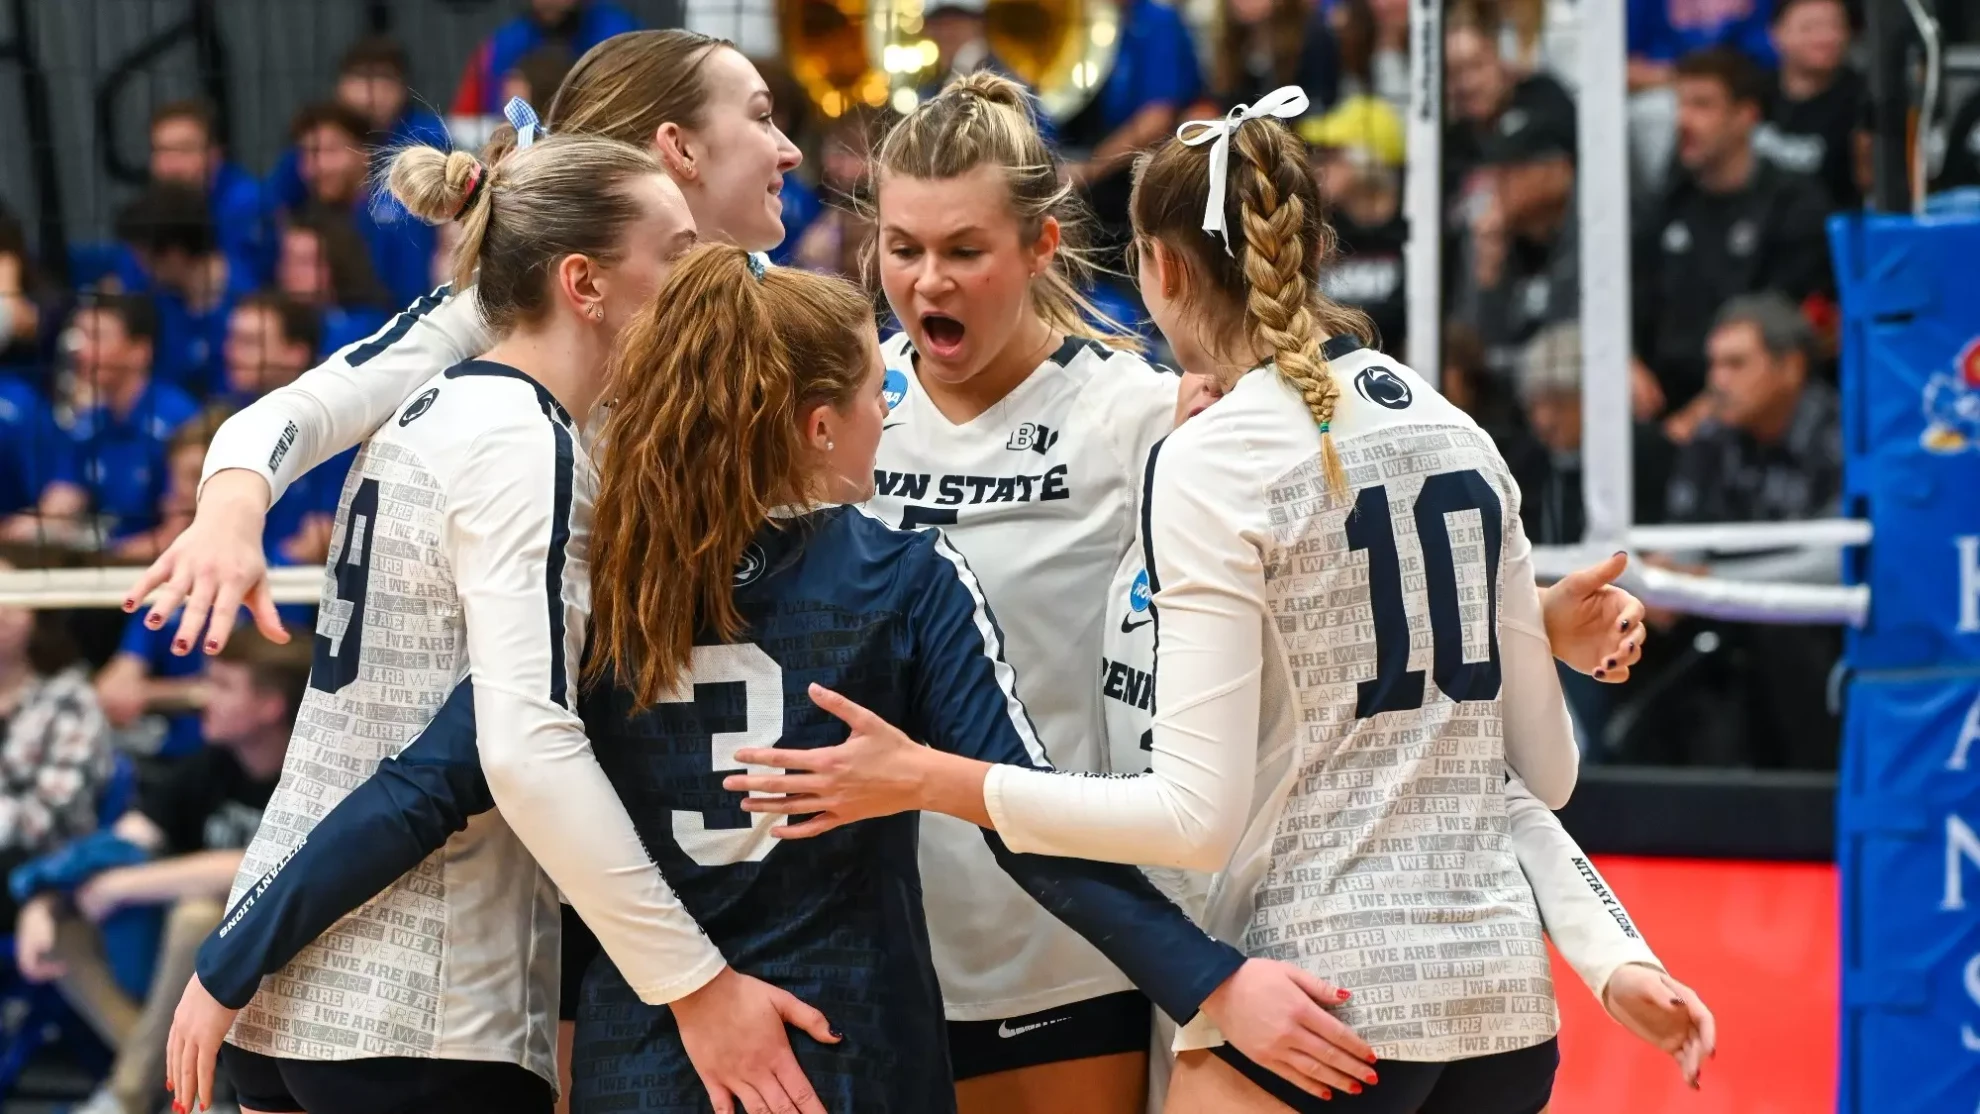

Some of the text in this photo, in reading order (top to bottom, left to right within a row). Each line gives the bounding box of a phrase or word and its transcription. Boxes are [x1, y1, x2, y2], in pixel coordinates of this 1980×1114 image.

[1362, 442, 1397, 461] ARE
[1383, 457, 1408, 477] WE
[1412, 453, 1441, 472] ARE
[874, 463, 1070, 505] NN STATE
[1271, 482, 1310, 505] ARE
[1303, 553, 1335, 575] WE
[310, 477, 379, 694] 9
[1273, 571, 1349, 595] WE ARE
[1284, 594, 1326, 613] ARE
[1345, 469, 1504, 720] 10
[1305, 611, 1338, 631] WE
[419, 636, 455, 651] ARE
[1314, 628, 1351, 646] ARE
[395, 652, 430, 669] ARE
[1334, 645, 1367, 663] WE
[410, 672, 440, 687] WE
[1309, 667, 1341, 686] WE
[1316, 684, 1356, 703] ARE
[1389, 727, 1424, 745] ARE
[657, 643, 789, 866] 3
[1362, 749, 1397, 765] ARE
[1336, 770, 1374, 788] ARE
[1446, 778, 1479, 793] ARE
[1287, 815, 1321, 833] ARE
[1423, 796, 1459, 813] ARE
[1303, 832, 1338, 850] WE
[1401, 817, 1432, 833] ARE
[1380, 834, 1450, 853] ARE WE
[1358, 853, 1466, 872] ARE WE ARE
[1283, 867, 1322, 885] ARE
[1303, 879, 1333, 899] WE
[1335, 873, 1374, 892] ARE
[1571, 857, 1617, 906] NITTANY
[1391, 892, 1425, 907] ARE
[219, 895, 256, 939] LIONS
[376, 906, 418, 929] ARE
[1284, 919, 1323, 939] ARE
[1330, 914, 1364, 931] WE
[1370, 909, 1404, 926] ARE
[1412, 908, 1439, 925] WE
[1442, 907, 1475, 923] ARE
[343, 918, 423, 950] ARE WE
[1306, 935, 1340, 955] WE
[1344, 928, 1385, 948] ARE
[1391, 928, 1418, 943] WE
[1489, 923, 1519, 938] ARE
[361, 941, 391, 960] WE
[1318, 952, 1358, 970] ARE
[1403, 945, 1437, 961] ARE
[1441, 943, 1467, 958] WE
[1470, 941, 1501, 957] ARE
[363, 961, 404, 982] ARE
[1339, 970, 1371, 988] WE
[1379, 964, 1416, 982] ARE
[1422, 962, 1449, 979] WE
[1452, 960, 1484, 977] ARE
[280, 980, 303, 999] WE
[305, 986, 343, 1008] ARE
[302, 965, 412, 1004] WE ARE WE
[1399, 983, 1426, 999] WE
[1432, 981, 1461, 997] ARE
[1496, 978, 1528, 994] ARE
[1411, 1002, 1442, 1018] ARE
[1446, 1000, 1469, 1016] WE
[1473, 998, 1505, 1014] ARE
[294, 1019, 320, 1038] WE
[324, 1028, 360, 1047] ARE
[351, 1013, 389, 1035] ARE
[1383, 1023, 1424, 1040] ARE
[1427, 1021, 1449, 1038] WE
[1450, 1018, 1481, 1034] ARE
[276, 1034, 297, 1053] WE
[298, 1040, 335, 1060] ARE
[1494, 1036, 1530, 1051] ARE
